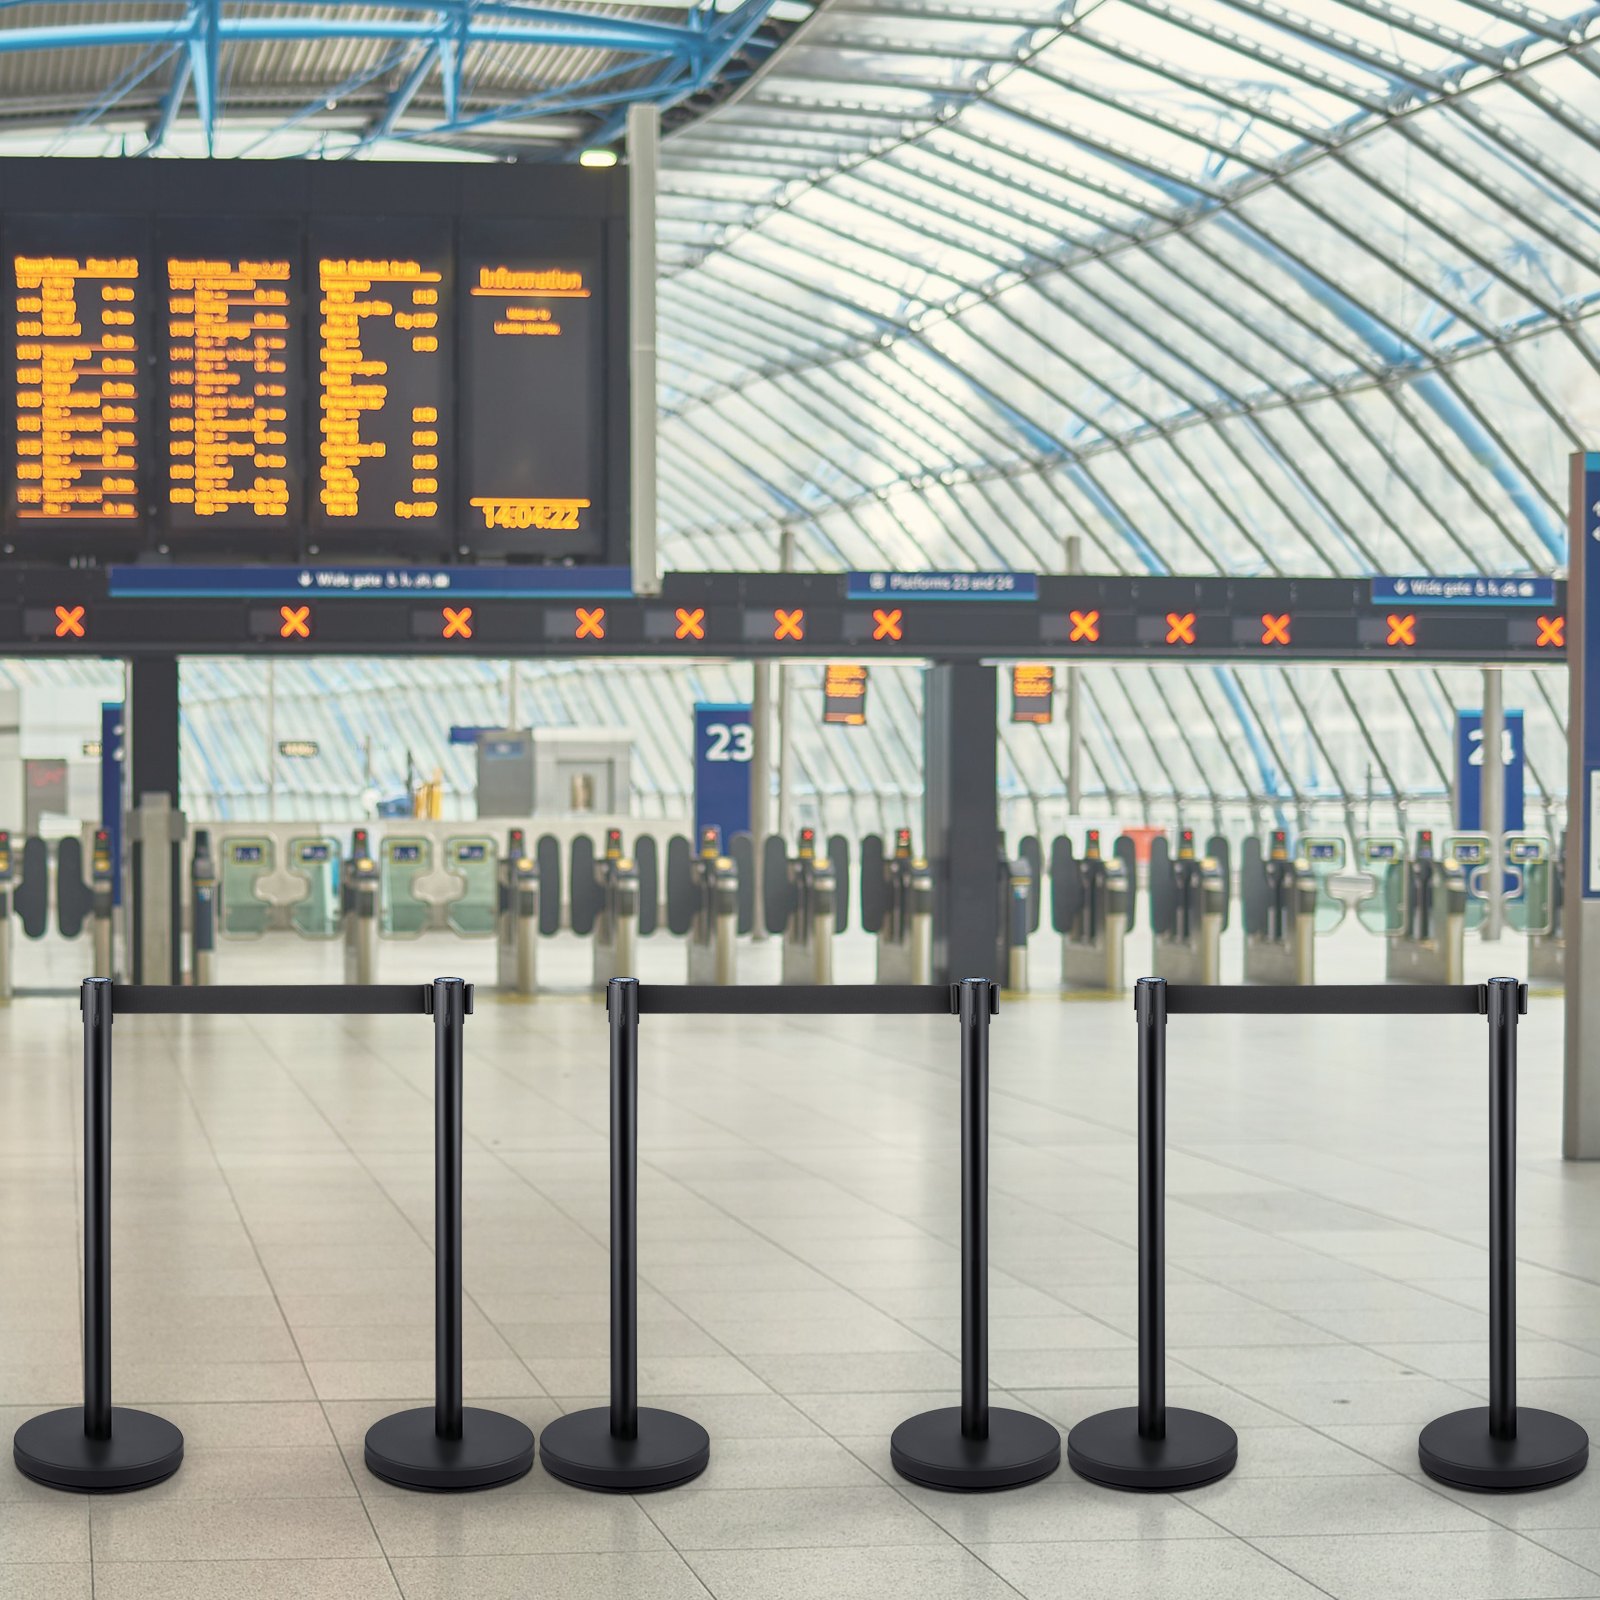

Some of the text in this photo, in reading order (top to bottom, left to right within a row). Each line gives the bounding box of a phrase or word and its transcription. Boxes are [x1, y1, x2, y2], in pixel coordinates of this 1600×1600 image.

[315, 570, 383, 590] Wide gate
[890, 574, 950, 591] Platforms
[971, 575, 994, 592] and
[1410, 579, 1472, 599] Wide gate
[705, 722, 754, 762] 23
